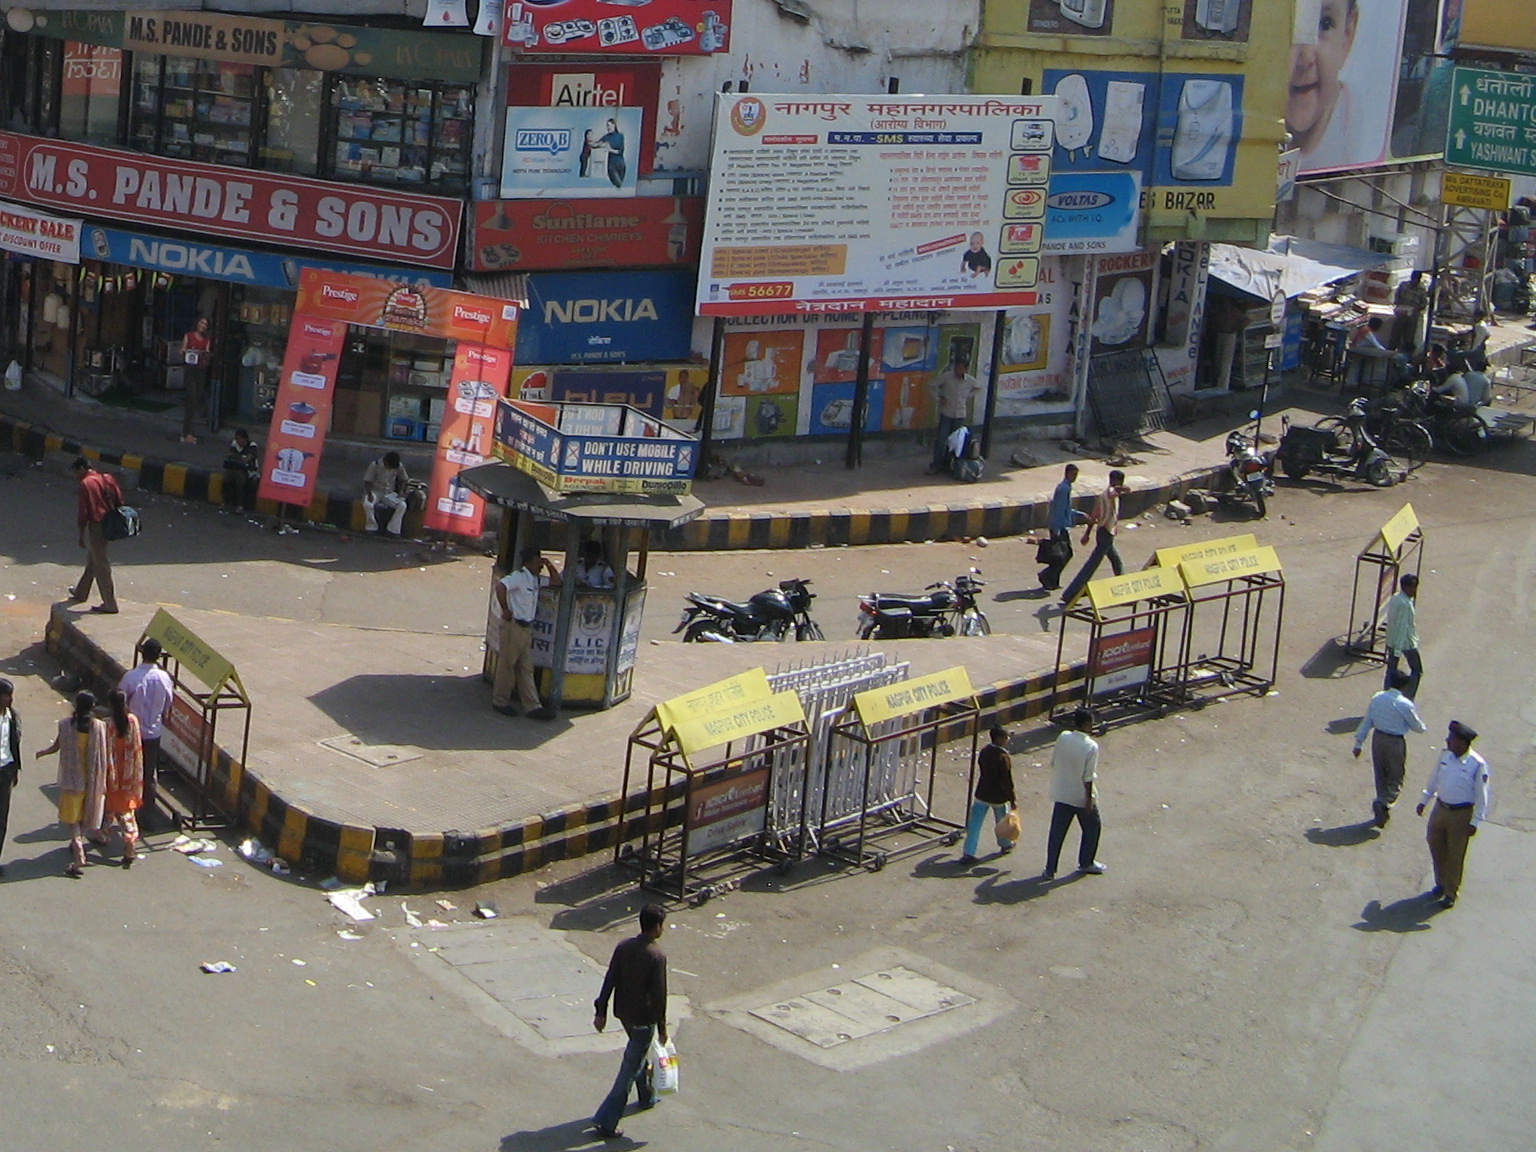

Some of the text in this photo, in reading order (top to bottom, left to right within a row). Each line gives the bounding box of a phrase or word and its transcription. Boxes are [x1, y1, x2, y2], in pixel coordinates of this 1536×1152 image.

[129, 17, 159, 44] M.S.
[162, 19, 213, 50] PANDE
[215, 28, 228, 50] &
[231, 28, 278, 57] SONS
[556, 82, 625, 106] Airtel
[773, 99, 1044, 122] नागपुर महानगरपालिका
[518, 131, 567, 147] ZERO B
[1470, 141, 1529, 166] YASHWANT
[29, 152, 444, 251] M.S. PANDE & SONS
[1057, 194, 1098, 206] VOLTAS
[1165, 191, 1216, 211] BAZAR
[39, 220, 75, 242] SALE
[532, 214, 641, 230] Sunflame
[537, 232, 643, 243] KITCHEN CHIMNEYS
[39, 240, 61, 254] OFFER
[129, 237, 256, 279] NOKIA
[322, 284, 359, 302] Prestige
[748, 285, 793, 298] 56677
[453, 306, 492, 325] Prestige
[544, 298, 659, 324] NOKIA
[304, 324, 333, 336] Prestige
[584, 441, 677, 459] DON'T USE MOBILE
[582, 459, 674, 476] WHILE DRIVING
